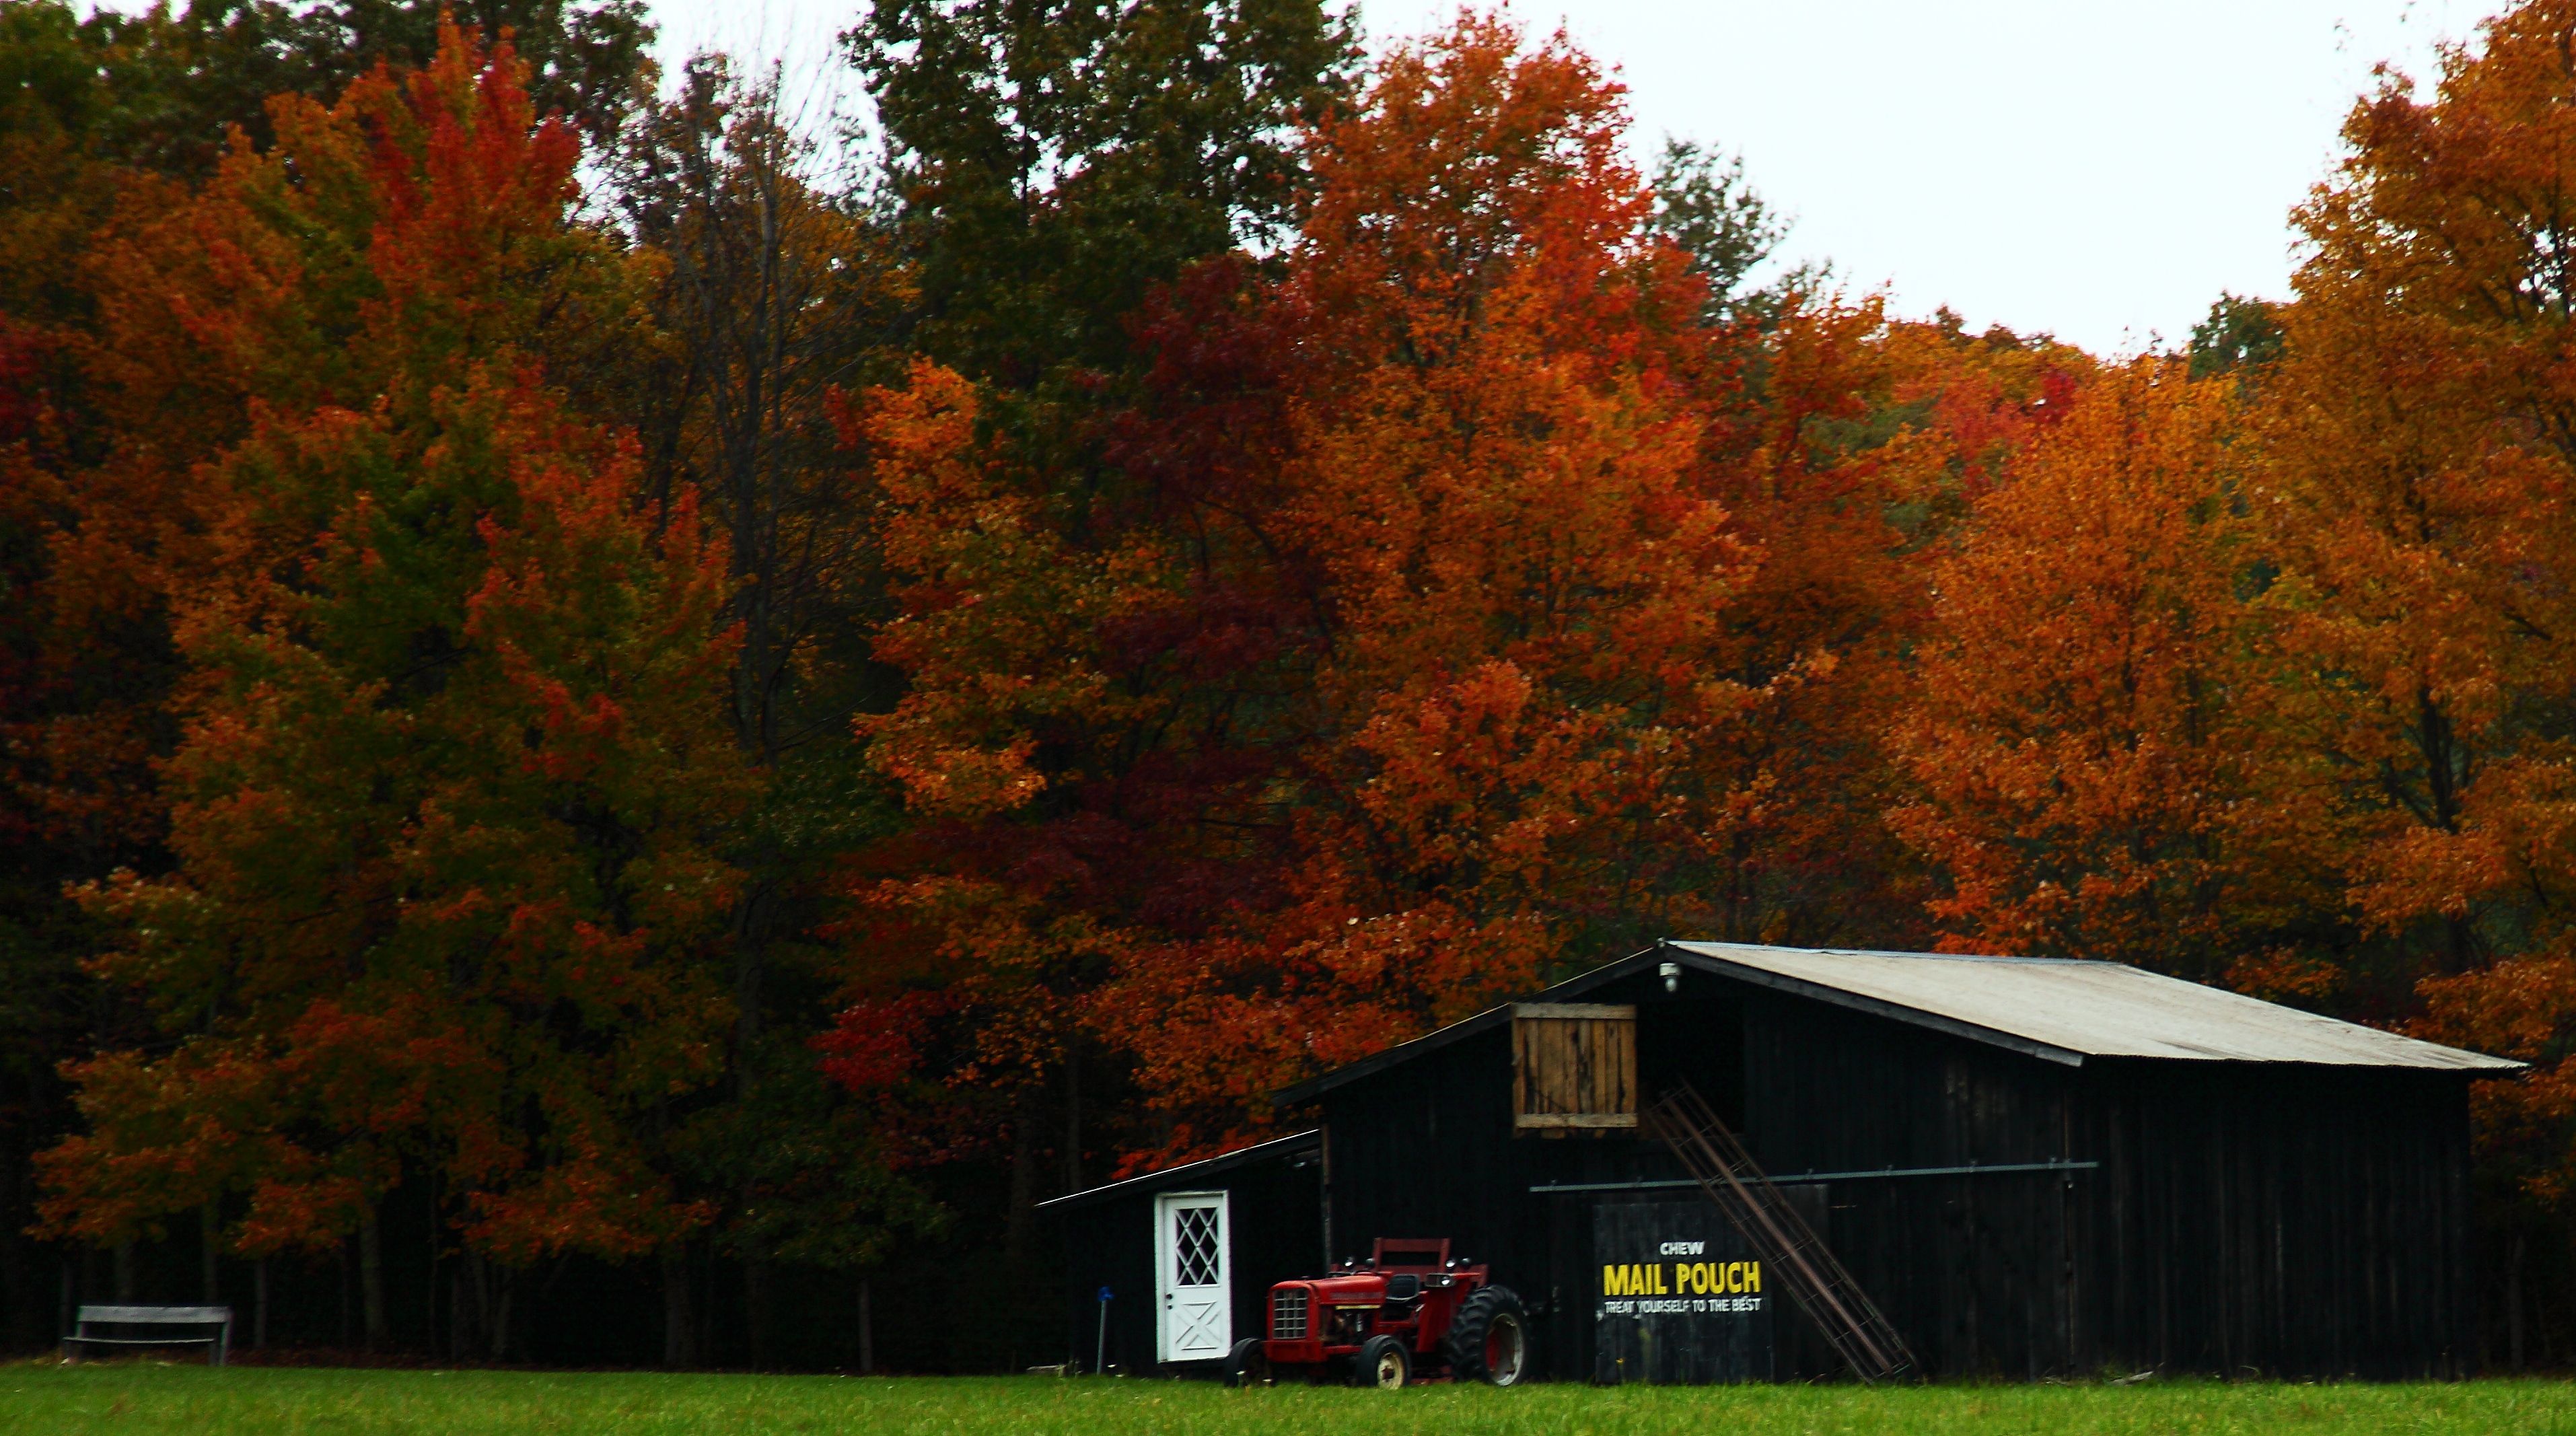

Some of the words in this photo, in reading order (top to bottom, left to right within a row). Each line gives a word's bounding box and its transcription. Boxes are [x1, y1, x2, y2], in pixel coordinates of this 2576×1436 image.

[1659, 1242, 1705, 1255] CHEW
[1604, 1264, 1668, 1295] MAIL
[1676, 1261, 1761, 1294] POUCH
[1604, 1300, 1635, 1314] TREAT
[1636, 1299, 1690, 1314] YOURSELF
[1692, 1299, 1706, 1313] TO
[1707, 1298, 1731, 1312] THE
[1732, 1297, 1761, 1312] BEST
